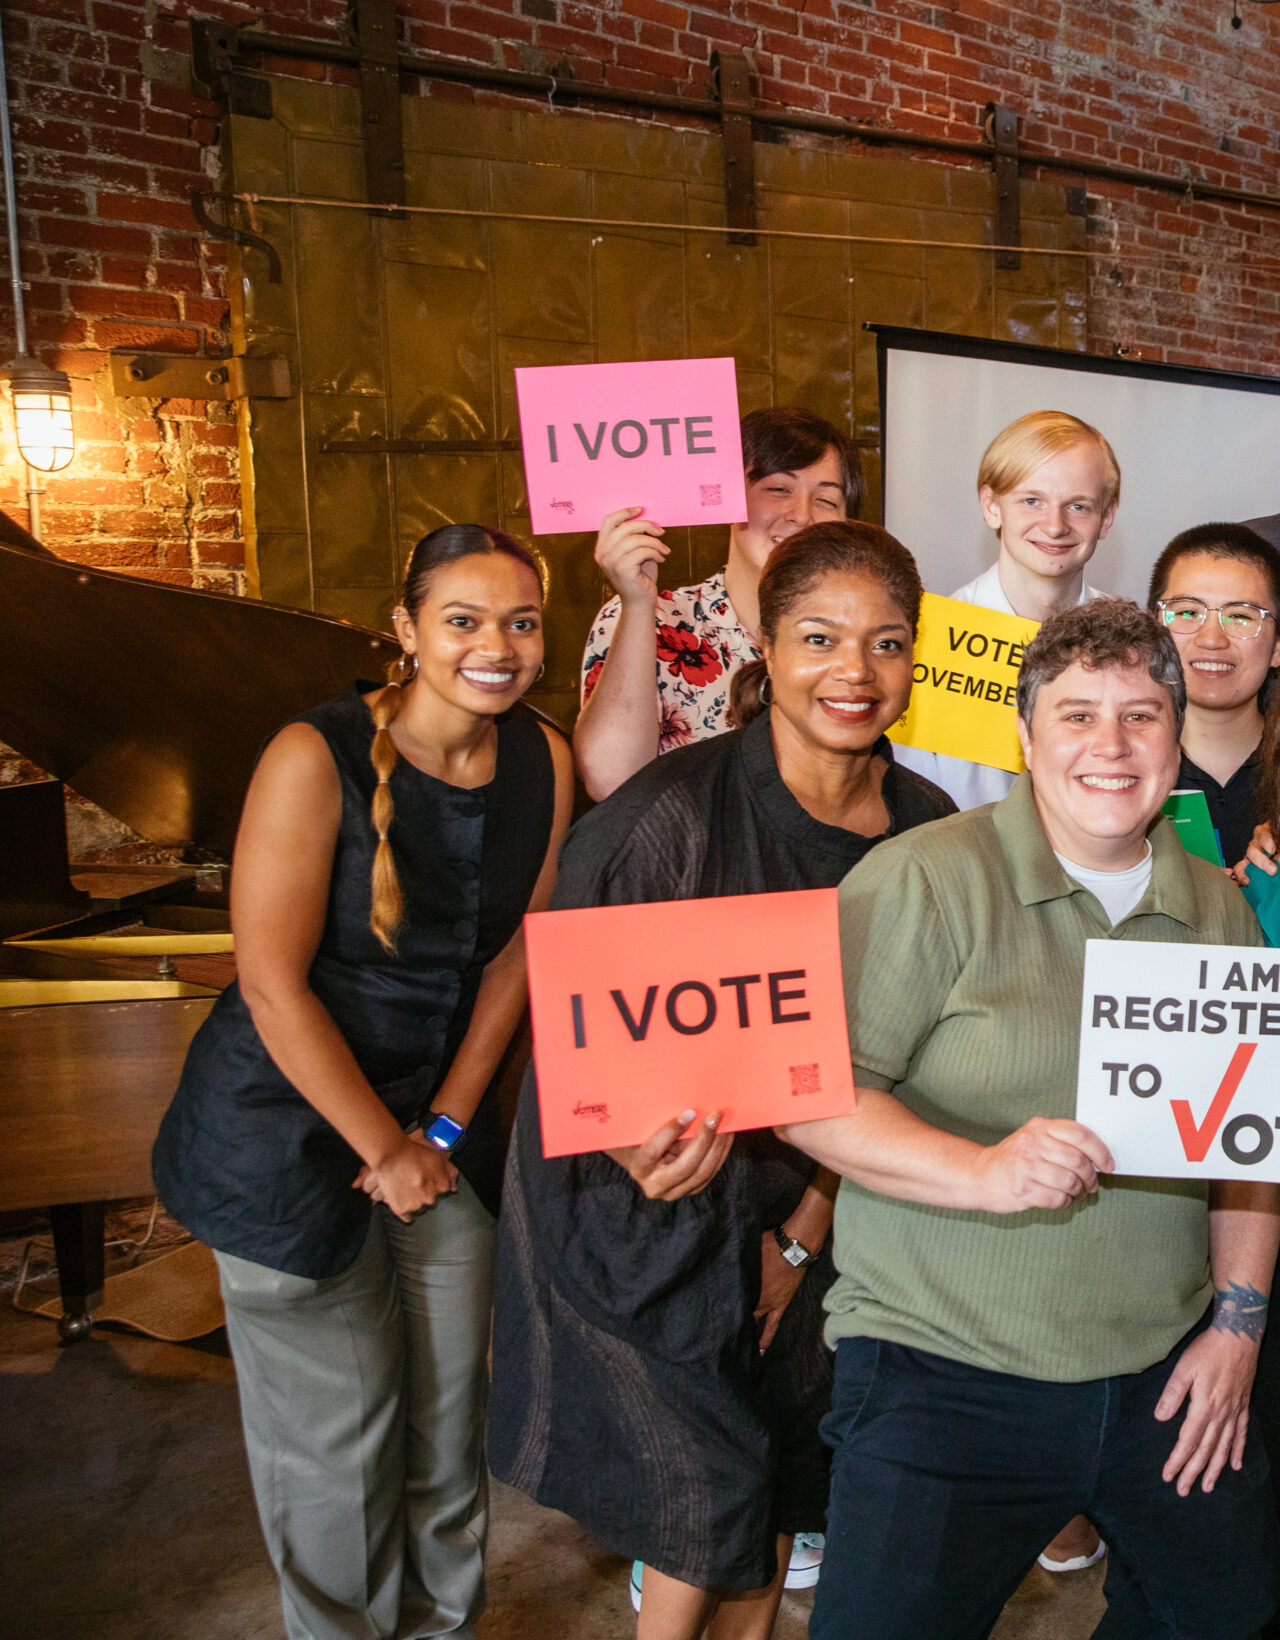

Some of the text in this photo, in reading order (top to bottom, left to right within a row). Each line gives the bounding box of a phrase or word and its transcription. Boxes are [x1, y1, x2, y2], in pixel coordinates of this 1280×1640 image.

[547, 416, 716, 463] I VOTE
[948, 626, 1024, 669] VOTE
[1199, 960, 1280, 993] I AM
[571, 968, 811, 1049] I VOTE
[1102, 1062, 1162, 1099] TO
